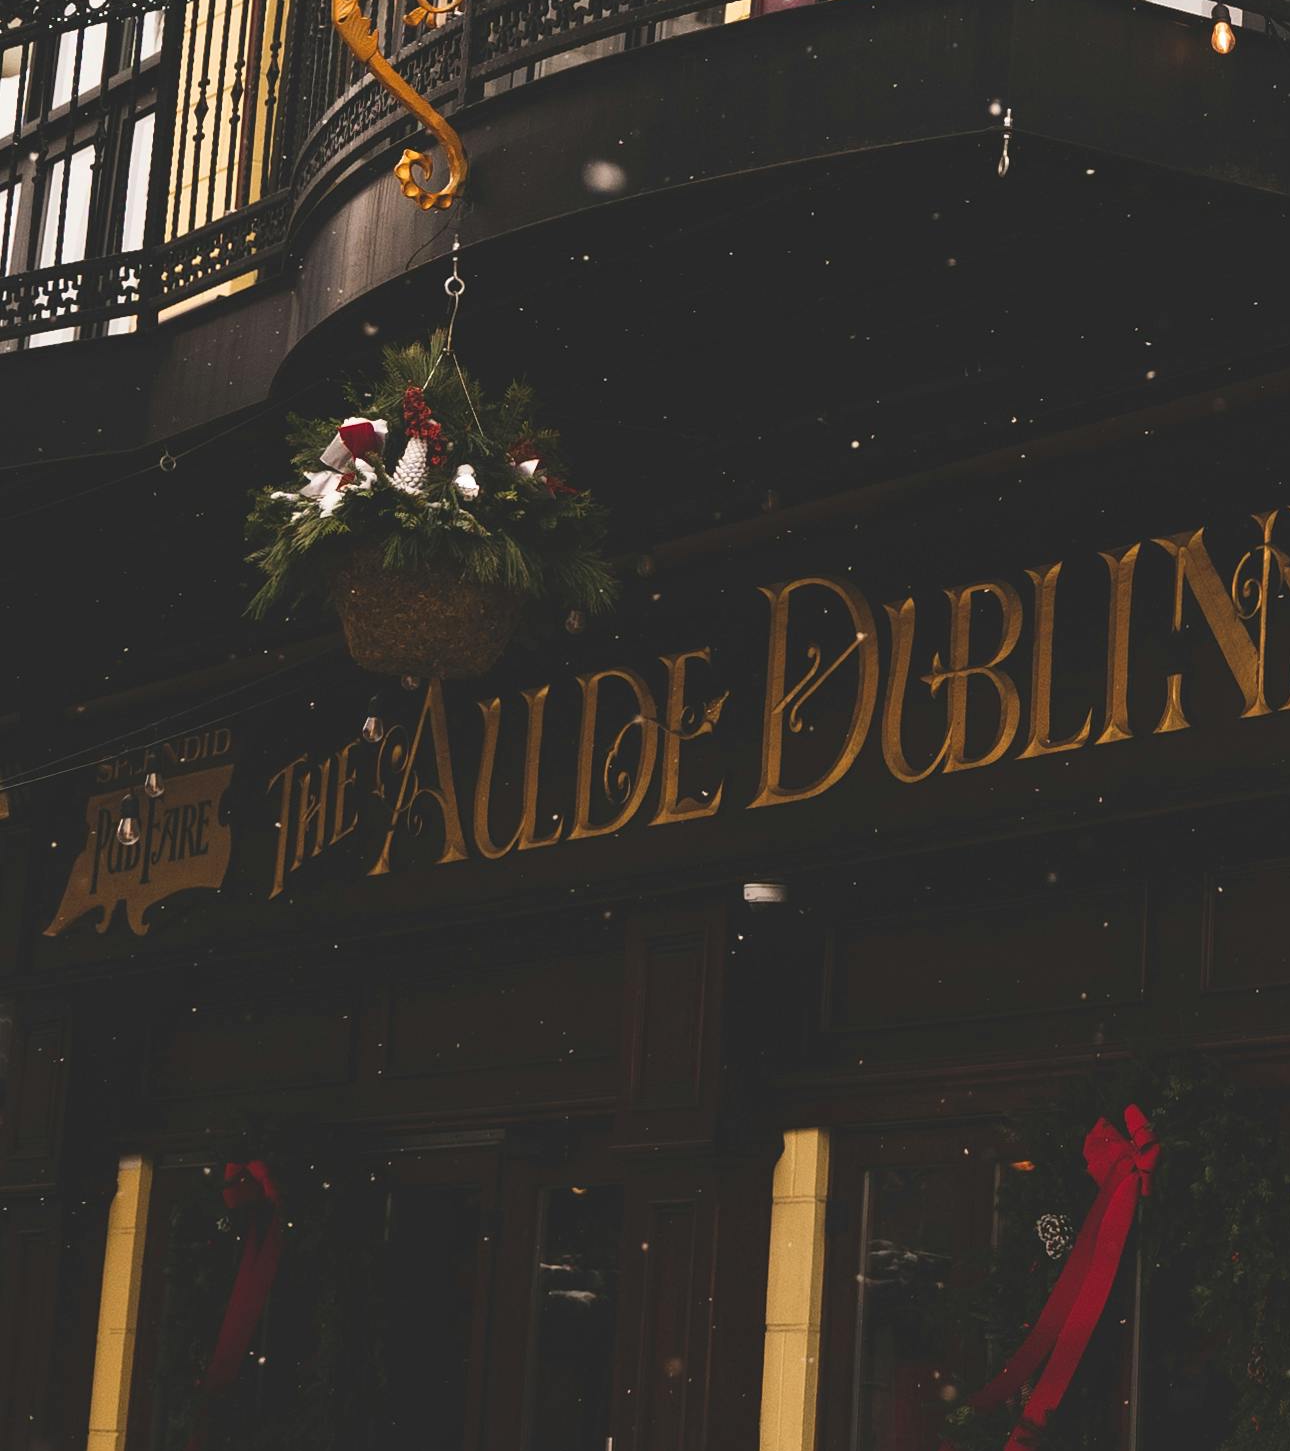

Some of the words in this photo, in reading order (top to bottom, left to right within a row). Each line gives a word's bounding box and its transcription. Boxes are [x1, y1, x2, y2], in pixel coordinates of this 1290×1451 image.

[139, 793, 212, 884] FARE
[267, 739, 362, 899] THE
[364, 647, 732, 878] AULDE
